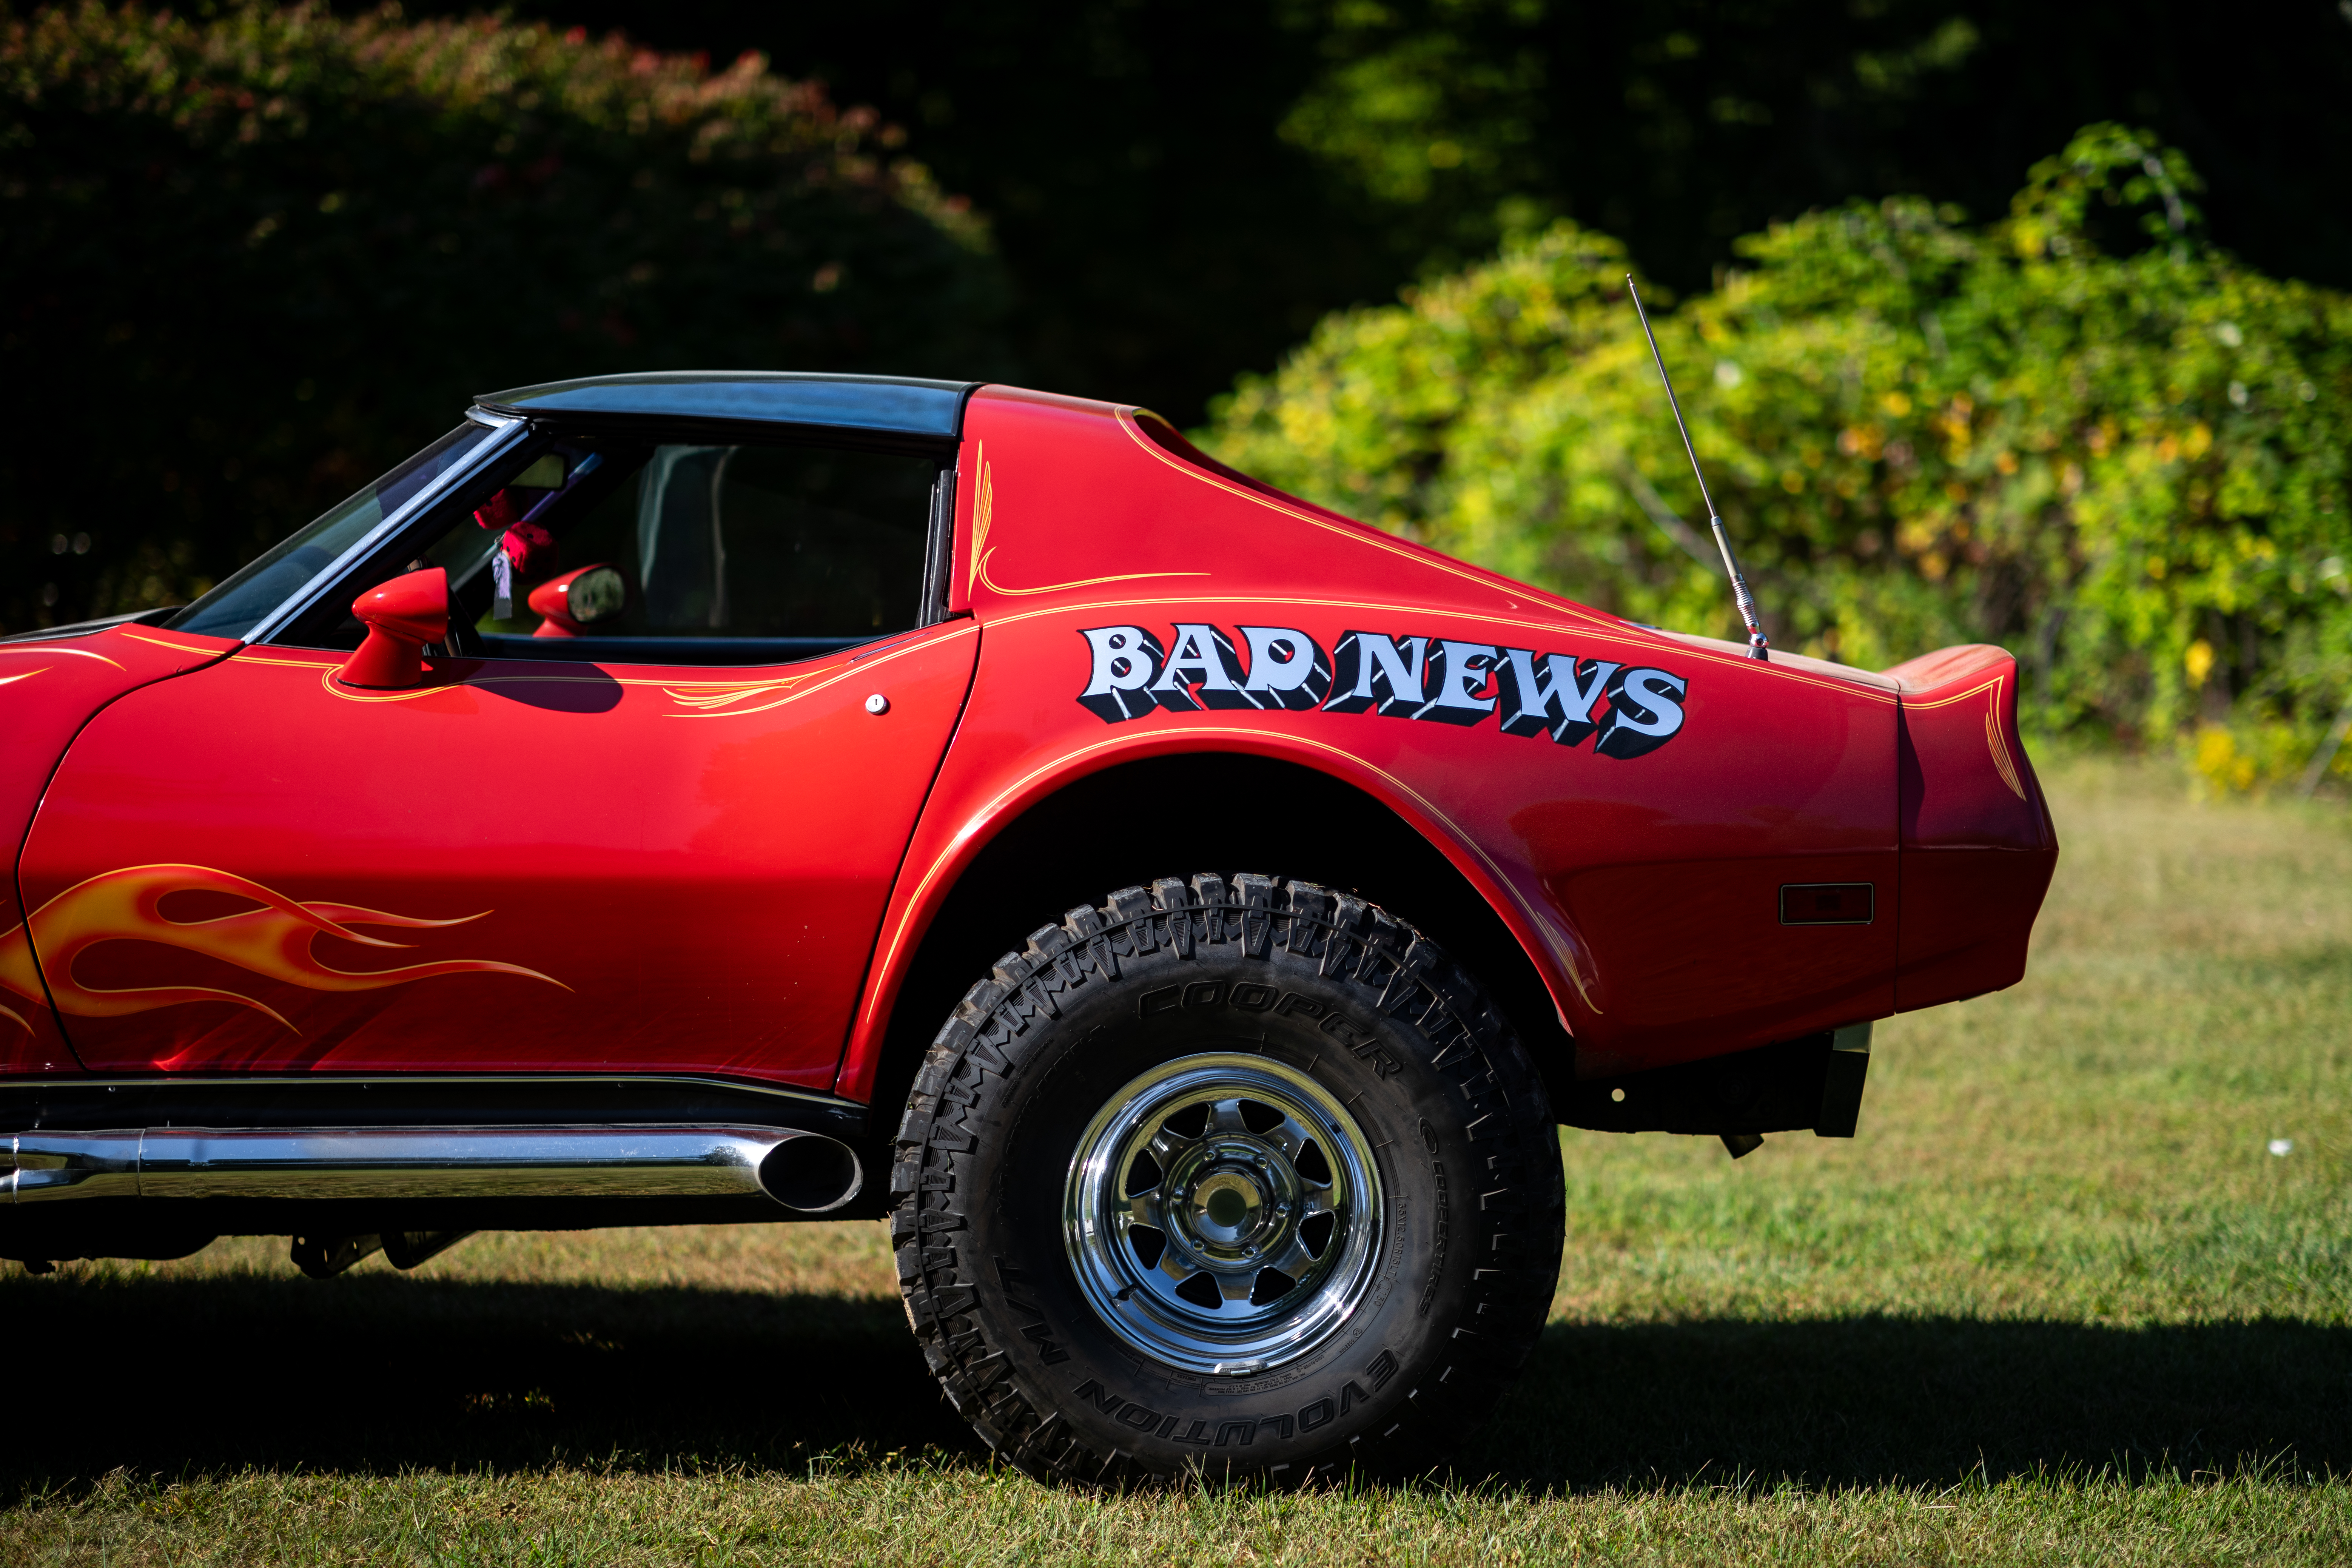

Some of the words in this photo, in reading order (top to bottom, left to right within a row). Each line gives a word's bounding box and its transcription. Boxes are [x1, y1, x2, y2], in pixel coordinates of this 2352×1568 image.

[1078, 623, 1331, 723] BAD
[1322, 630, 1688, 758] NEWS
[1138, 980, 1404, 1081] COOPER
[1388, 1202, 1407, 1277] 35X12.50R15LT
[992, 1255, 1071, 1366] M/T
[1373, 1286, 1389, 1307] 113Q
[1071, 1348, 1399, 1447] EVOLUTION
